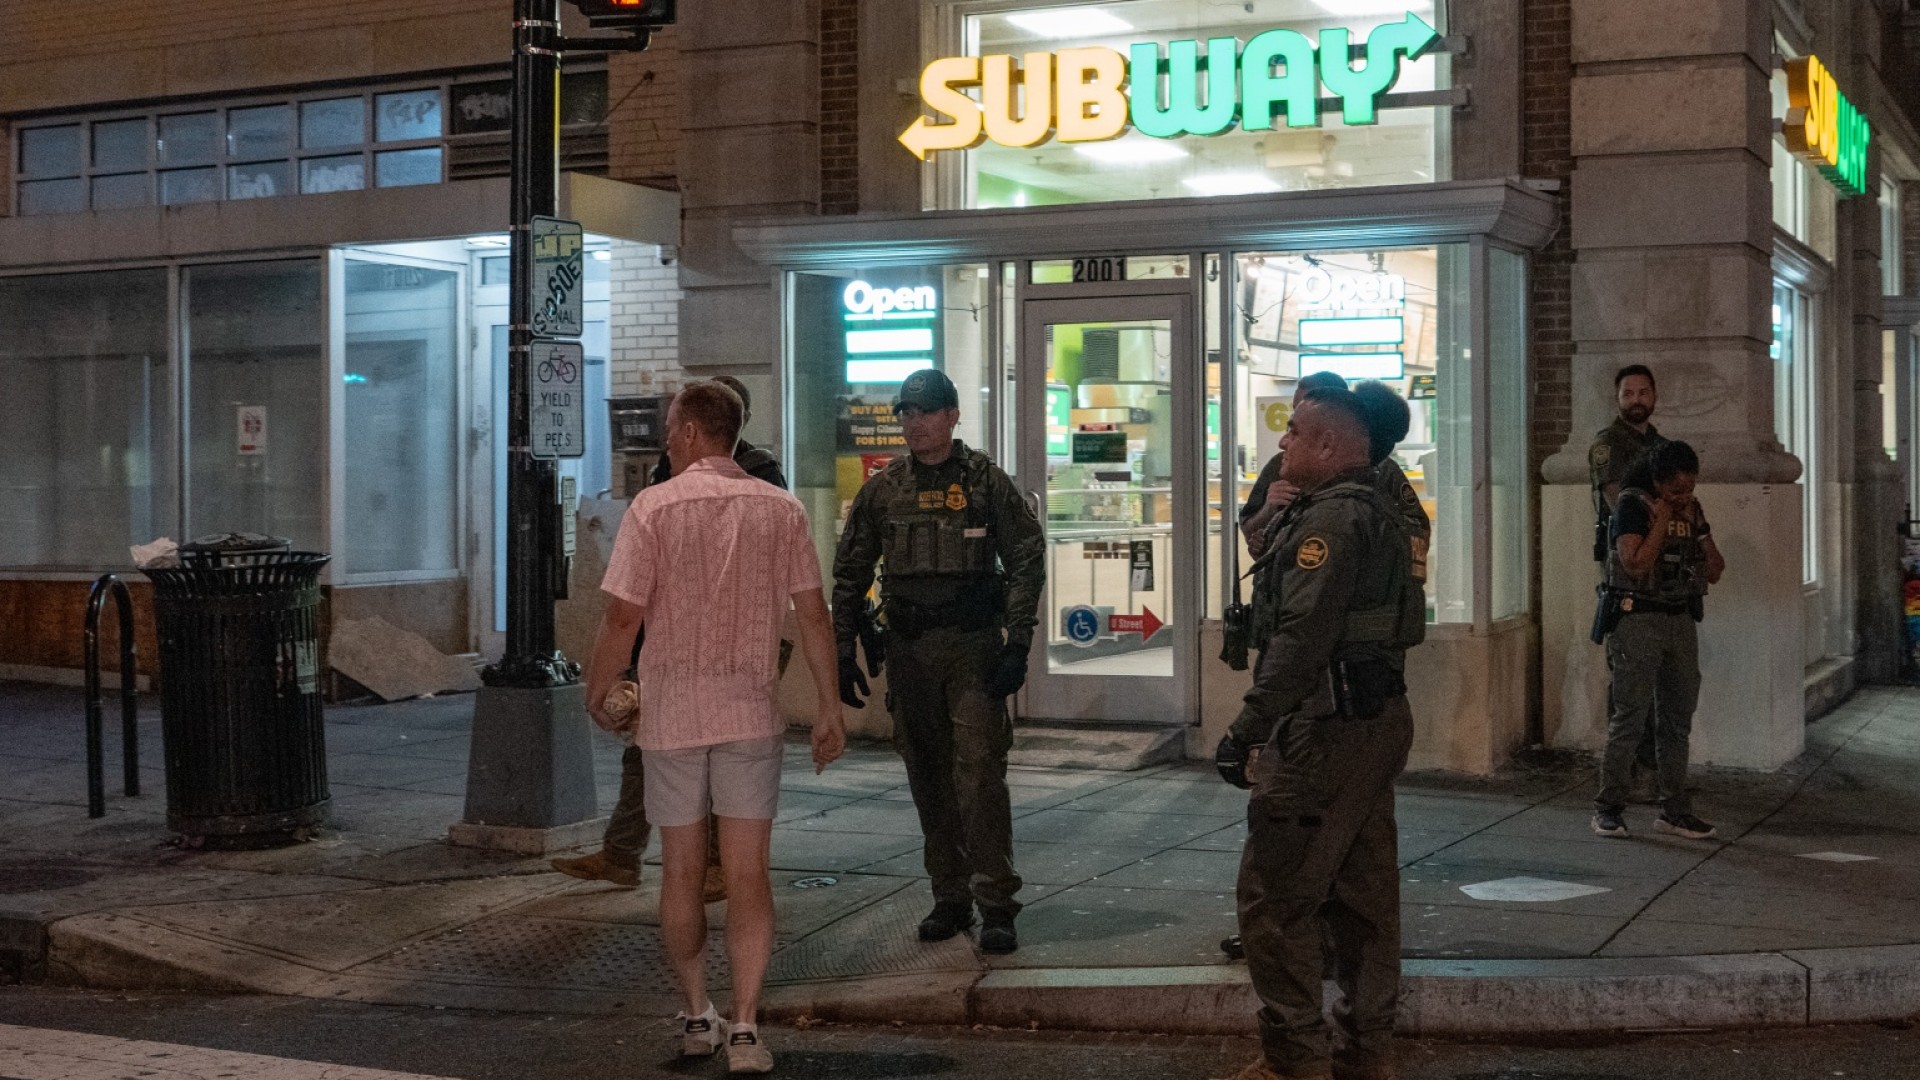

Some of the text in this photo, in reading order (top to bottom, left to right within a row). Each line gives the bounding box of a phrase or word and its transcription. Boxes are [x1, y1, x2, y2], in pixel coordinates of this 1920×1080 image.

[898, 14, 1437, 160] SUBWAY
[1805, 54, 1870, 194] SUBWAY
[1073, 258, 1124, 282] 2001
[1299, 266, 1405, 310] Open
[843, 280, 936, 320] Open
[541, 392, 571, 407] YIELD
[551, 412, 563, 427] TO
[855, 435, 876, 445] FOR
[1668, 521, 1691, 537] FBI
[1119, 618, 1143, 629] Street
